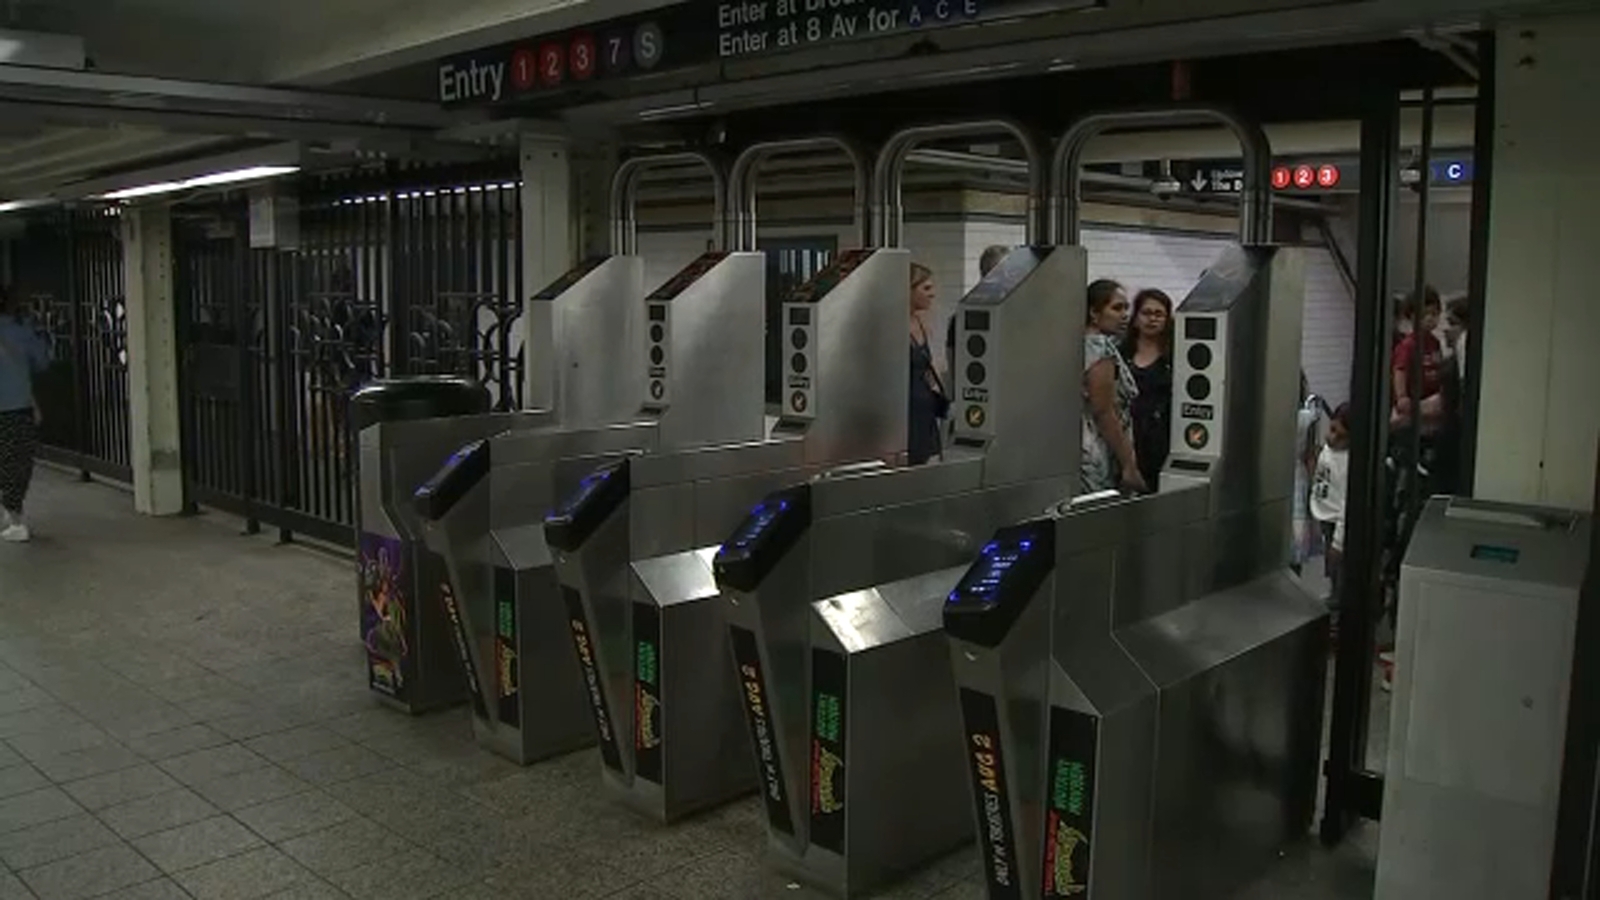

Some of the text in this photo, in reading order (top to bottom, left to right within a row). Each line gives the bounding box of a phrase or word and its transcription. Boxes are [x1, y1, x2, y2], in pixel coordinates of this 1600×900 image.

[718, 1, 768, 28] Enter
[718, 31, 768, 56] Enter
[777, 21, 798, 46] at
[806, 16, 821, 42] 8
[830, 14, 859, 39] Av
[867, 8, 900, 32] for
[908, 6, 922, 24] A
[935, 0, 950, 19] C
[440, 60, 504, 102] Entry
[547, 51, 559, 77] 2
[576, 44, 589, 70] 3
[608, 37, 621, 65] 7
[640, 31, 656, 59] S
[1321, 169, 1333, 184] 3
[1447, 163, 1461, 179] C
[1183, 404, 1213, 420] Entry
[741, 663, 757, 679] 2
[744, 681, 765, 717] AUG
[972, 732, 992, 750] 2
[974, 750, 999, 793] AUG
